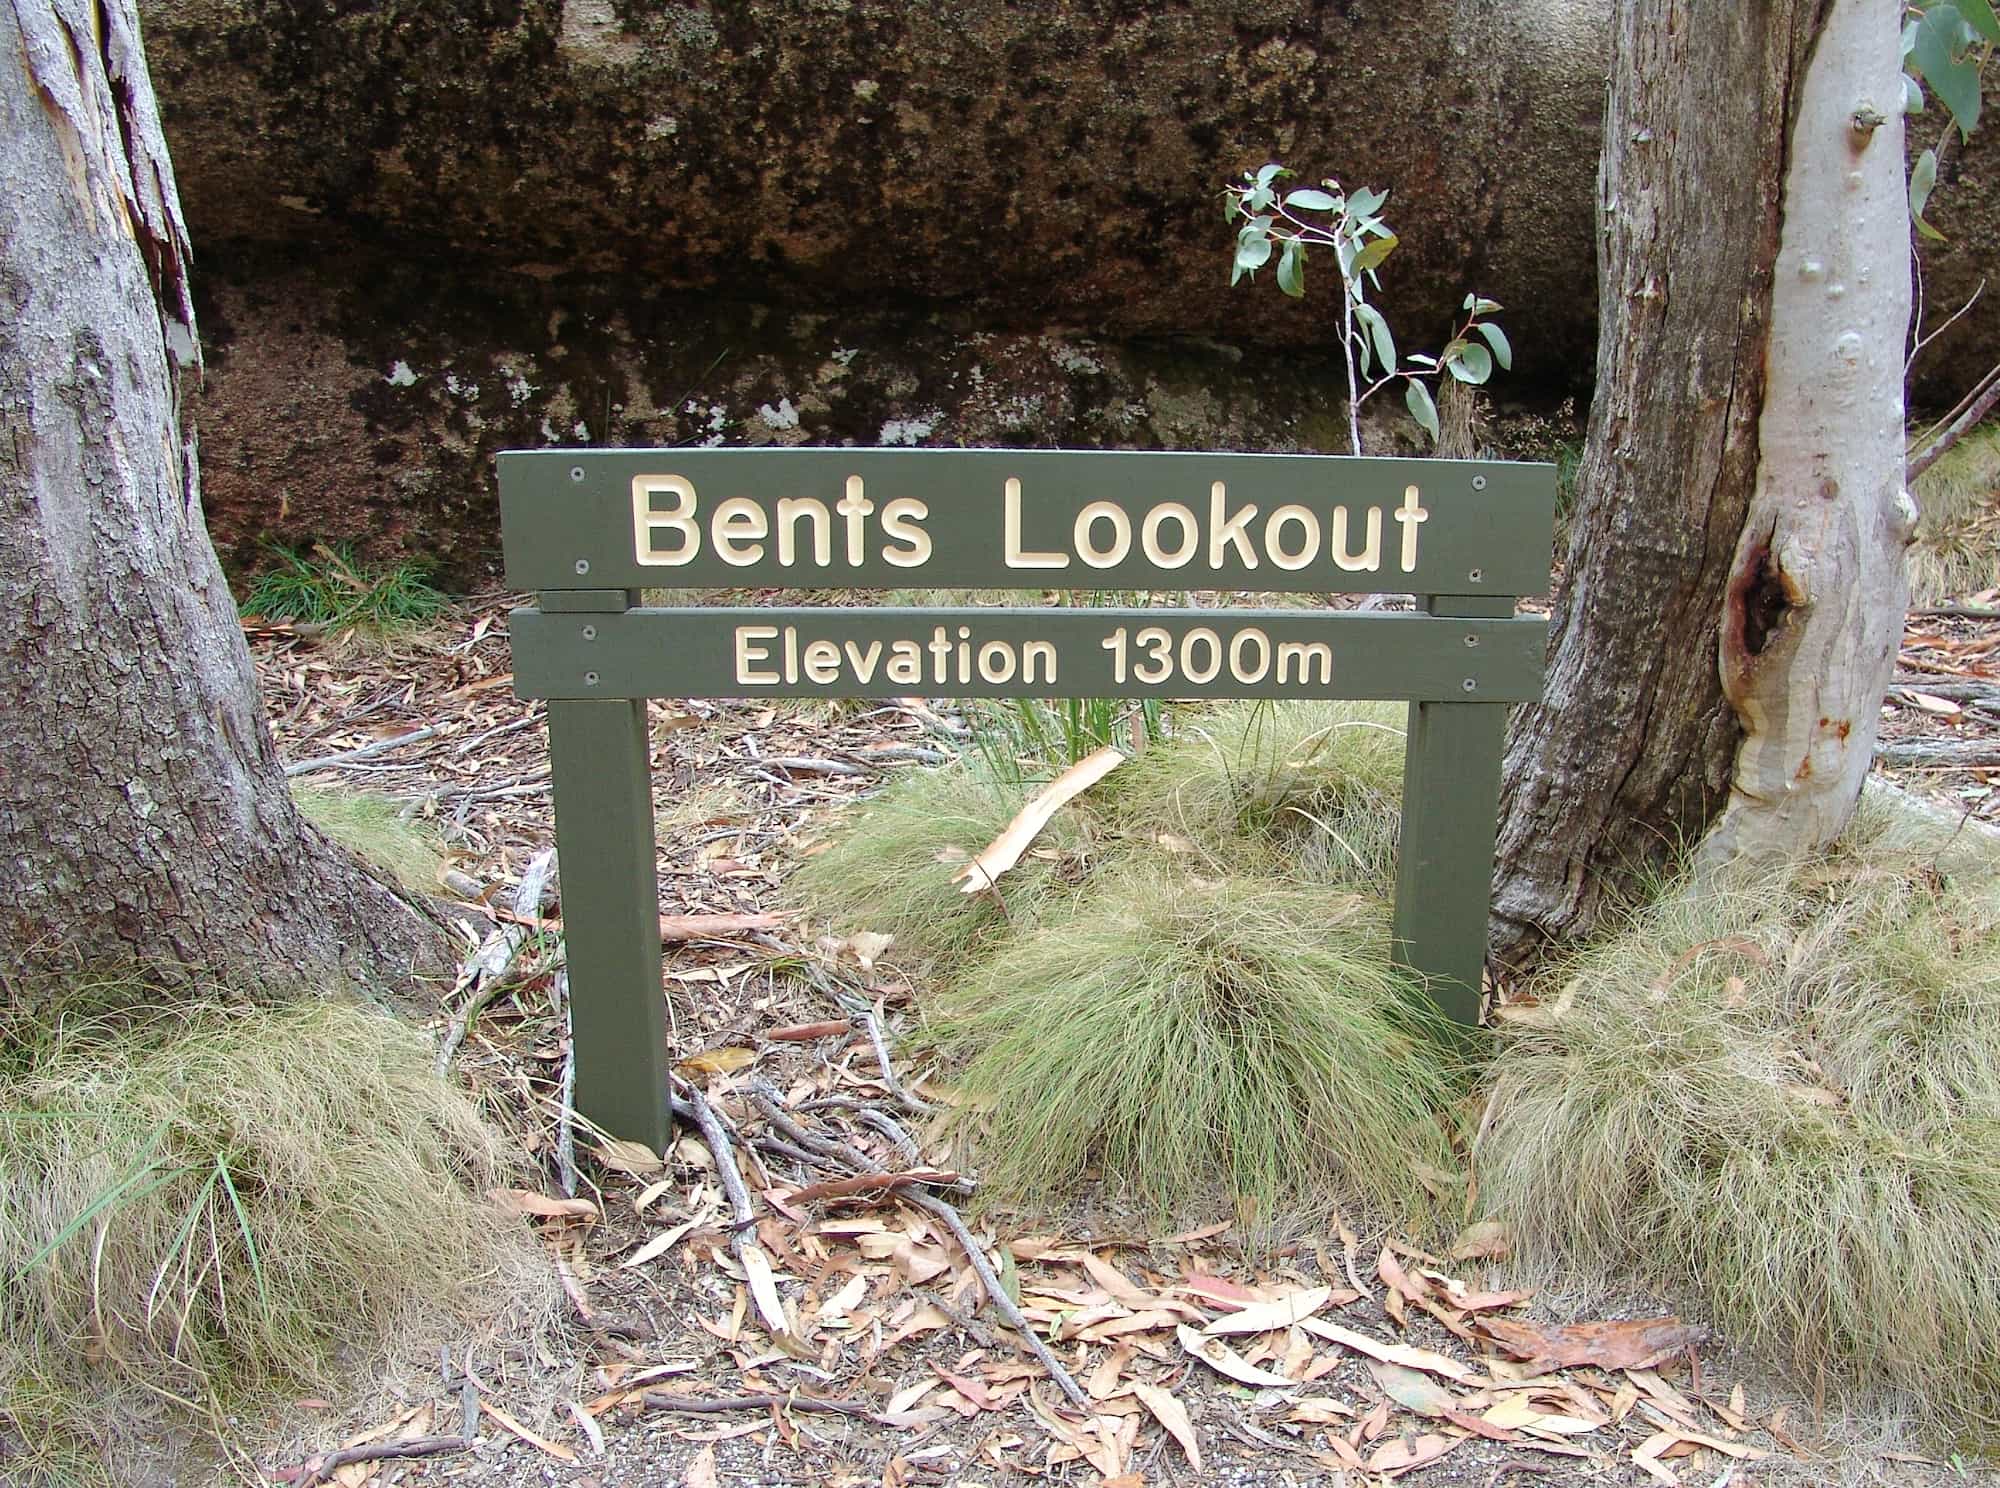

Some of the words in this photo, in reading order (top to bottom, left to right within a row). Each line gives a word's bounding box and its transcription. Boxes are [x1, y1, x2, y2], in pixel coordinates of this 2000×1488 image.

[631, 473, 933, 569] Bents
[1003, 477, 1430, 573] Lookout
[734, 625, 1058, 686] Elevation
[1101, 626, 1333, 686] 1300m
